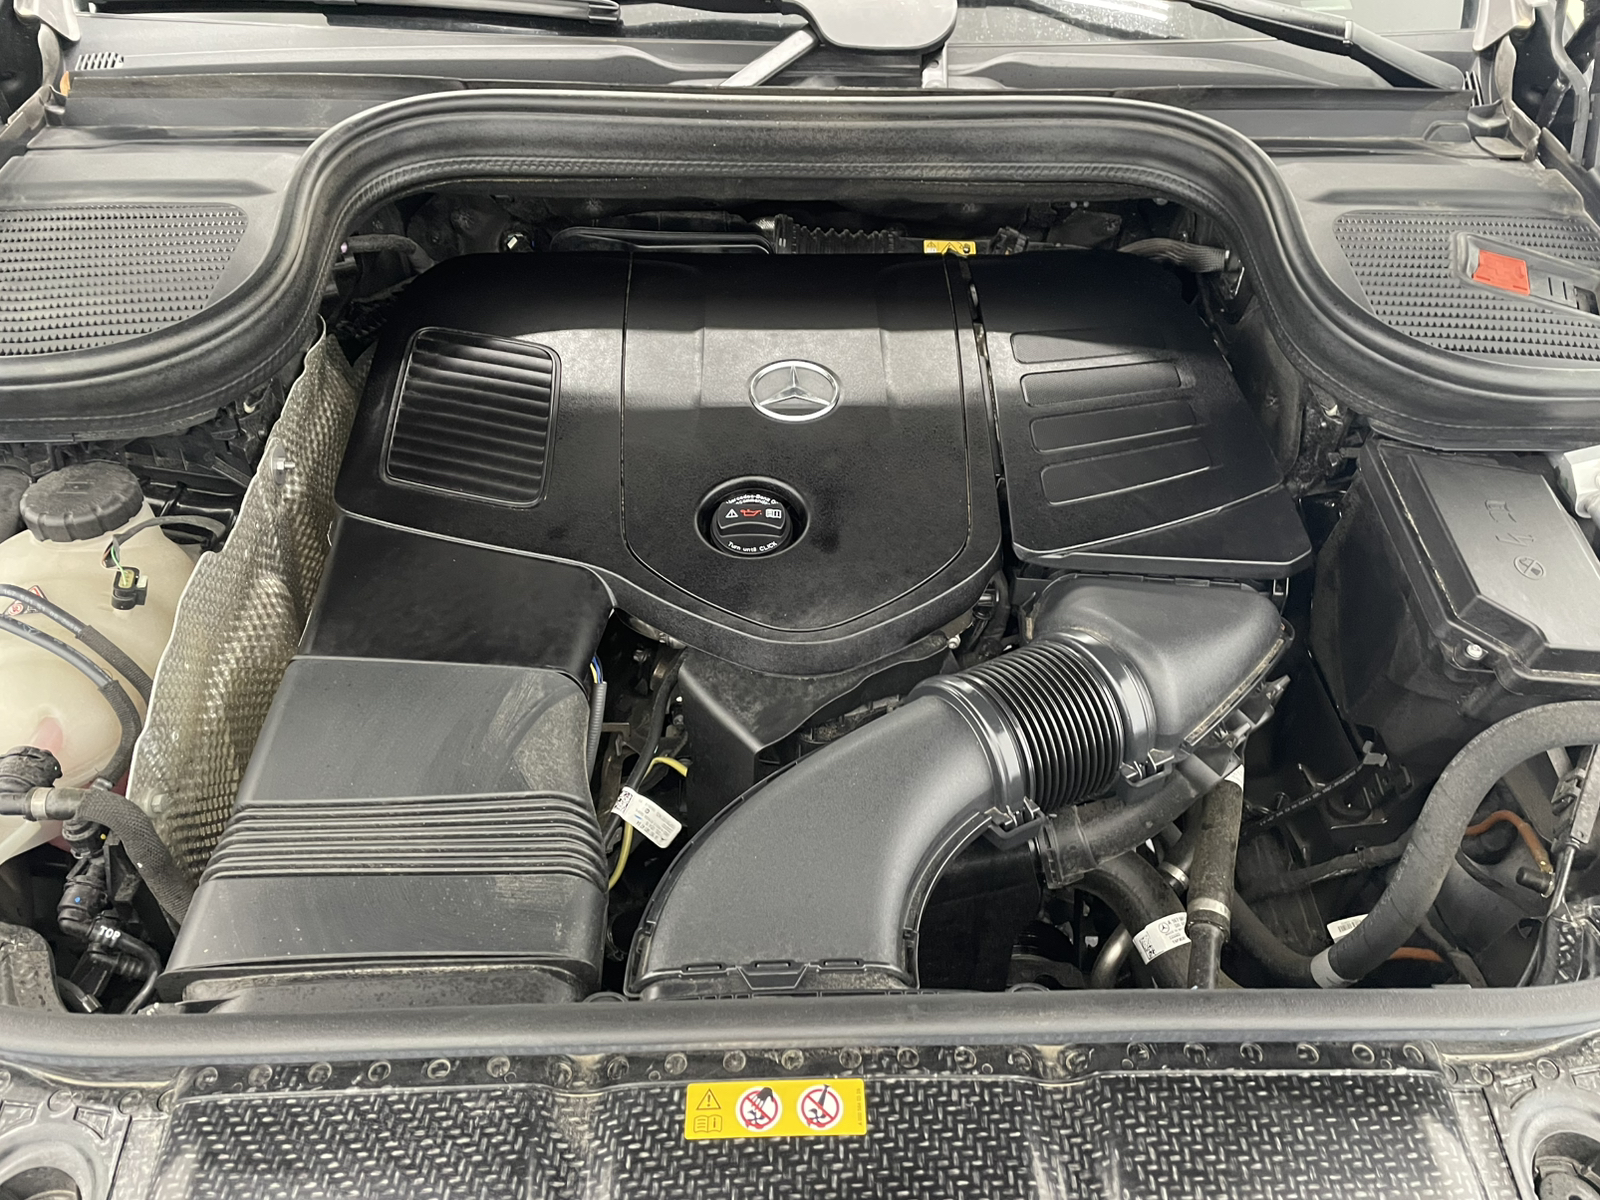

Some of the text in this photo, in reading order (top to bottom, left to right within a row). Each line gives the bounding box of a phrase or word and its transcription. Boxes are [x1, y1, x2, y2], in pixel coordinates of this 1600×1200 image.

[728, 541, 741, 551] Turn
[759, 541, 778, 552] CLICK
[99, 925, 121, 941] TOP
